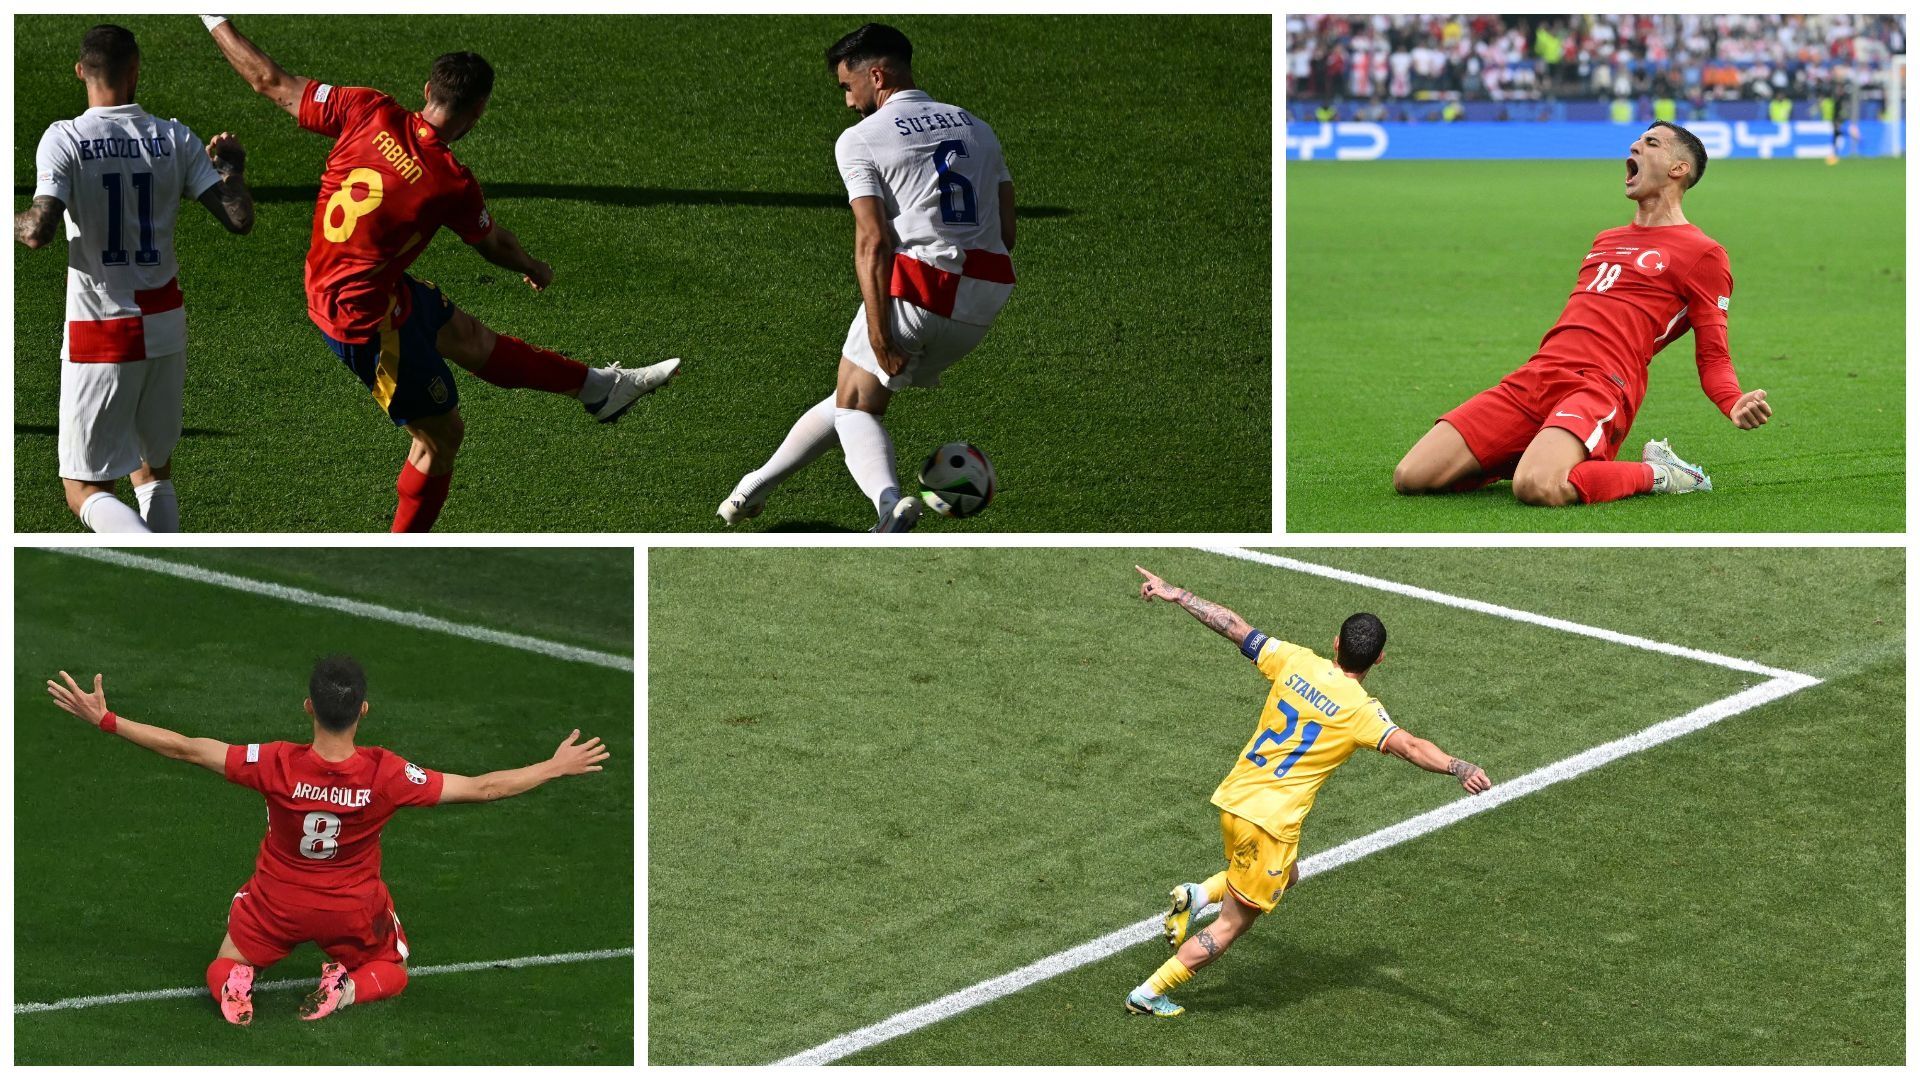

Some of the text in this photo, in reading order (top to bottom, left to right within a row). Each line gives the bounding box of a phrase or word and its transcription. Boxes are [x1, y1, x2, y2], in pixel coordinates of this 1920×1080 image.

[372, 131, 423, 184] FABIÁN
[1684, 121, 1834, 159] BYD
[323, 167, 384, 243] 8
[933, 140, 979, 226] 6
[102, 172, 160, 266] 11
[1586, 262, 1622, 292] 18
[1285, 674, 1341, 718] STANCIU
[1246, 698, 1323, 778] 21
[292, 781, 371, 807] ARDA GÜLER
[300, 811, 341, 860] 8
